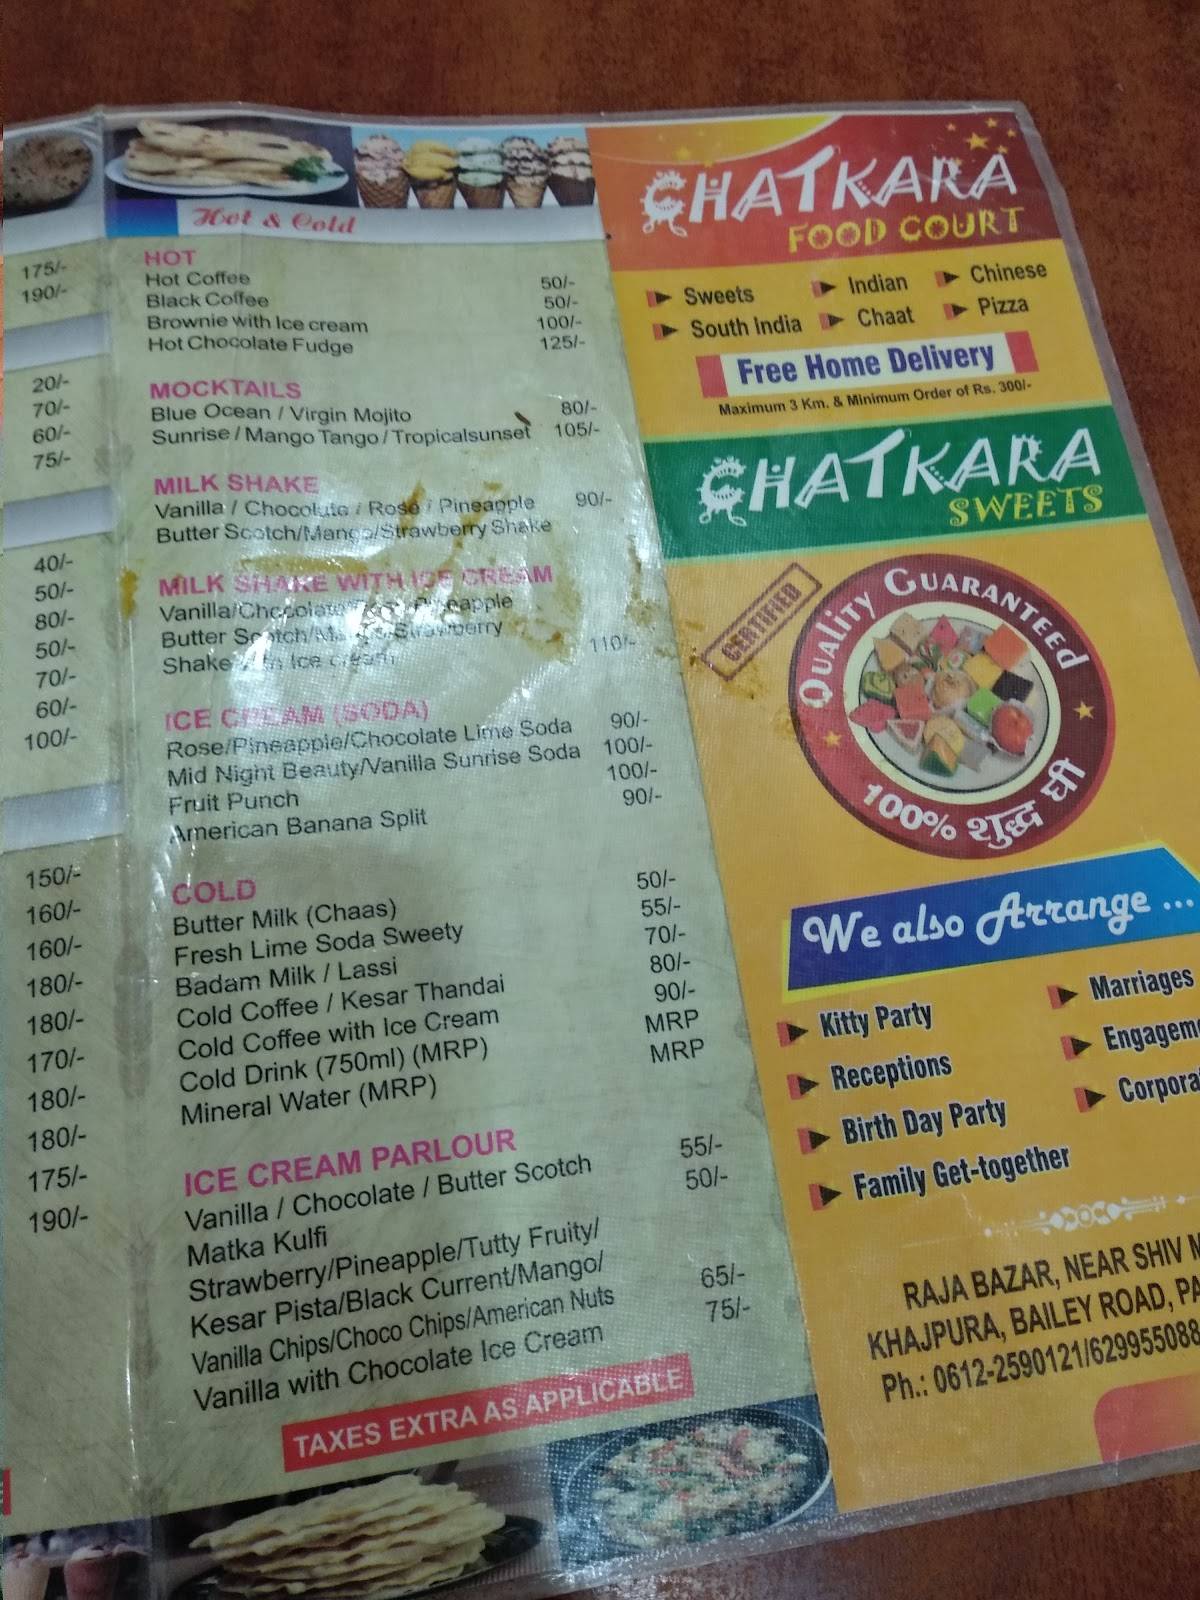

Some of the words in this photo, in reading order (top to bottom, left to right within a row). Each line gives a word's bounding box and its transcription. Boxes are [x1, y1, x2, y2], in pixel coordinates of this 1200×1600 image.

[640, 145, 1017, 237] CHATKARA
[192, 207, 251, 227] Hot
[262, 214, 281, 230] &
[292, 213, 356, 234] Cold
[788, 218, 886, 253] FOOD
[899, 207, 1024, 240] COURT
[22, 261, 67, 280] 175/-
[145, 250, 196, 267] HOT
[146, 272, 179, 287] Hot
[186, 271, 250, 286] Coffee
[541, 276, 575, 290] 50/-
[848, 274, 908, 294] Indian
[970, 262, 1047, 283] Chinese
[21, 284, 68, 304] 190/-
[146, 292, 201, 308] Black
[205, 292, 269, 308] Coffee
[544, 296, 578, 310] 50/-
[684, 286, 754, 306] Sweets
[978, 297, 1029, 315] Pizza
[147, 314, 228, 331] Brownie
[232, 314, 271, 332] with
[275, 317, 306, 332] Ice
[310, 320, 368, 334] cream
[538, 315, 582, 331] 100/-
[691, 318, 747, 339] South
[755, 316, 802, 335] India
[857, 306, 915, 327] Chaat
[149, 336, 182, 351] Hot
[186, 335, 288, 352] Chocolate
[293, 338, 353, 355] Fudge
[541, 335, 585, 350] 125/-
[737, 356, 798, 385] Free
[804, 349, 881, 380] Home
[890, 343, 995, 372] Delivery
[33, 374, 69, 393] 20/-
[151, 380, 301, 399] MOCKTAILS
[33, 400, 70, 417] 70/-
[561, 402, 597, 416] 80/-
[719, 401, 786, 417] Maximum
[789, 399, 798, 412] 3
[802, 397, 829, 409] Km.
[834, 395, 842, 407] &
[847, 390, 910, 407] Minimum
[913, 387, 953, 401] Order
[956, 385, 970, 397] of
[973, 383, 996, 396] Rs.
[998, 380, 1033, 394] 300/-
[151, 406, 197, 422] Blue
[203, 404, 270, 420] Ocean
[291, 406, 348, 425] Virgin
[354, 407, 411, 425] Mojito
[33, 425, 70, 444] 60/-
[153, 426, 230, 445] Sunrise
[246, 428, 315, 447] Mango
[322, 429, 378, 448] Tango
[392, 425, 530, 446] Tropicalsunset
[554, 421, 600, 437] 105/-
[33, 450, 70, 469] 75/-
[155, 477, 219, 494] MILK
[228, 476, 318, 493] SHAKE
[697, 427, 1101, 527] CHATKARA
[576, 491, 612, 507] 90/-
[948, 484, 1104, 527] SWEETS
[34, 554, 73, 574] 40/-
[34, 611, 74, 631] 80/-
[36, 669, 76, 689] 70/-
[24, 729, 77, 751] 100/-
[169, 796, 219, 815] Fruit
[227, 790, 299, 810] Punch
[863, 782, 958, 841] 100%
[966, 800, 1044, 850] शुद्ध
[1041, 757, 1086, 802] घी
[171, 820, 279, 843] American
[286, 813, 372, 835] Banana
[381, 808, 428, 831] Split
[26, 864, 81, 889] 150/-
[172, 880, 256, 905] COLD
[26, 900, 81, 925] 160/-
[173, 913, 244, 936] Butter
[252, 905, 298, 929] Milk
[306, 899, 397, 926] (Chaas)
[803, 911, 882, 954] We
[892, 903, 965, 945] also
[976, 891, 1151, 946] Arrange
[174, 942, 242, 967] Fresh
[250, 936, 307, 958] Lime
[315, 930, 375, 952] Soda
[382, 923, 463, 949] Sweety
[176, 974, 261, 998] Badam
[270, 965, 315, 989] Milk
[339, 956, 398, 980] Lassi
[1089, 968, 1195, 1001] Marriages
[177, 1005, 232, 1029] Cold
[240, 997, 318, 1023] Coffee
[341, 987, 407, 1011] Kesar
[415, 974, 505, 1004] Thandai
[819, 1010, 869, 1039] Kitty
[875, 1002, 932, 1031] Party
[28, 1046, 85, 1073] 170/-
[650, 1039, 705, 1064] MRP
[180, 1069, 237, 1094] Cold
[245, 1060, 308, 1087] Drink
[316, 1047, 406, 1082] (750ml)
[412, 1036, 489, 1070] (MRP)
[830, 1055, 952, 1091] Receptions
[1119, 1066, 1200, 1104] Corpora
[181, 1098, 272, 1126] Mineral
[280, 1086, 350, 1114] Water
[359, 1073, 438, 1108] (MRP)
[842, 1115, 897, 1145] Birth
[903, 1109, 943, 1137] Day
[949, 1099, 1007, 1130] Party
[680, 1136, 723, 1159] 55/-
[185, 1168, 238, 1198] ICE
[247, 1150, 362, 1188] CREAM
[372, 1128, 517, 1170] PARLOUR
[853, 1166, 926, 1201] Family
[933, 1146, 1071, 1189] Get-together
[28, 1164, 87, 1191] 175/-
[29, 1206, 88, 1233] 190/-
[188, 1239, 265, 1266] Matka
[273, 1226, 328, 1255] Kulfi
[903, 1274, 970, 1311] RAJA
[971, 1259, 1060, 1298] BAZAR,
[1063, 1247, 1130, 1282] NEAR
[1132, 1232, 1182, 1271] SHIV
[190, 1310, 266, 1338] Kesar
[275, 1283, 414, 1325] Pista/Black
[421, 1251, 604, 1302] Current/Mango/
[706, 1298, 751, 1321] 75/-
[867, 1312, 1006, 1361] KHAJPURA,
[1009, 1293, 1092, 1336] BAILEY
[1098, 1281, 1174, 1321] ROAD,
[194, 1382, 280, 1411] Vanilla
[287, 1369, 340, 1395] with
[348, 1345, 473, 1385] Chocolate
[481, 1338, 517, 1360] Ice
[524, 1326, 604, 1353] Cream
[881, 1371, 929, 1402] Ph.:
[293, 1426, 381, 1459] TAXES
[389, 1405, 478, 1441] EXTRA
[485, 1399, 517, 1421] AS
[525, 1368, 684, 1415] APPLICABLE
